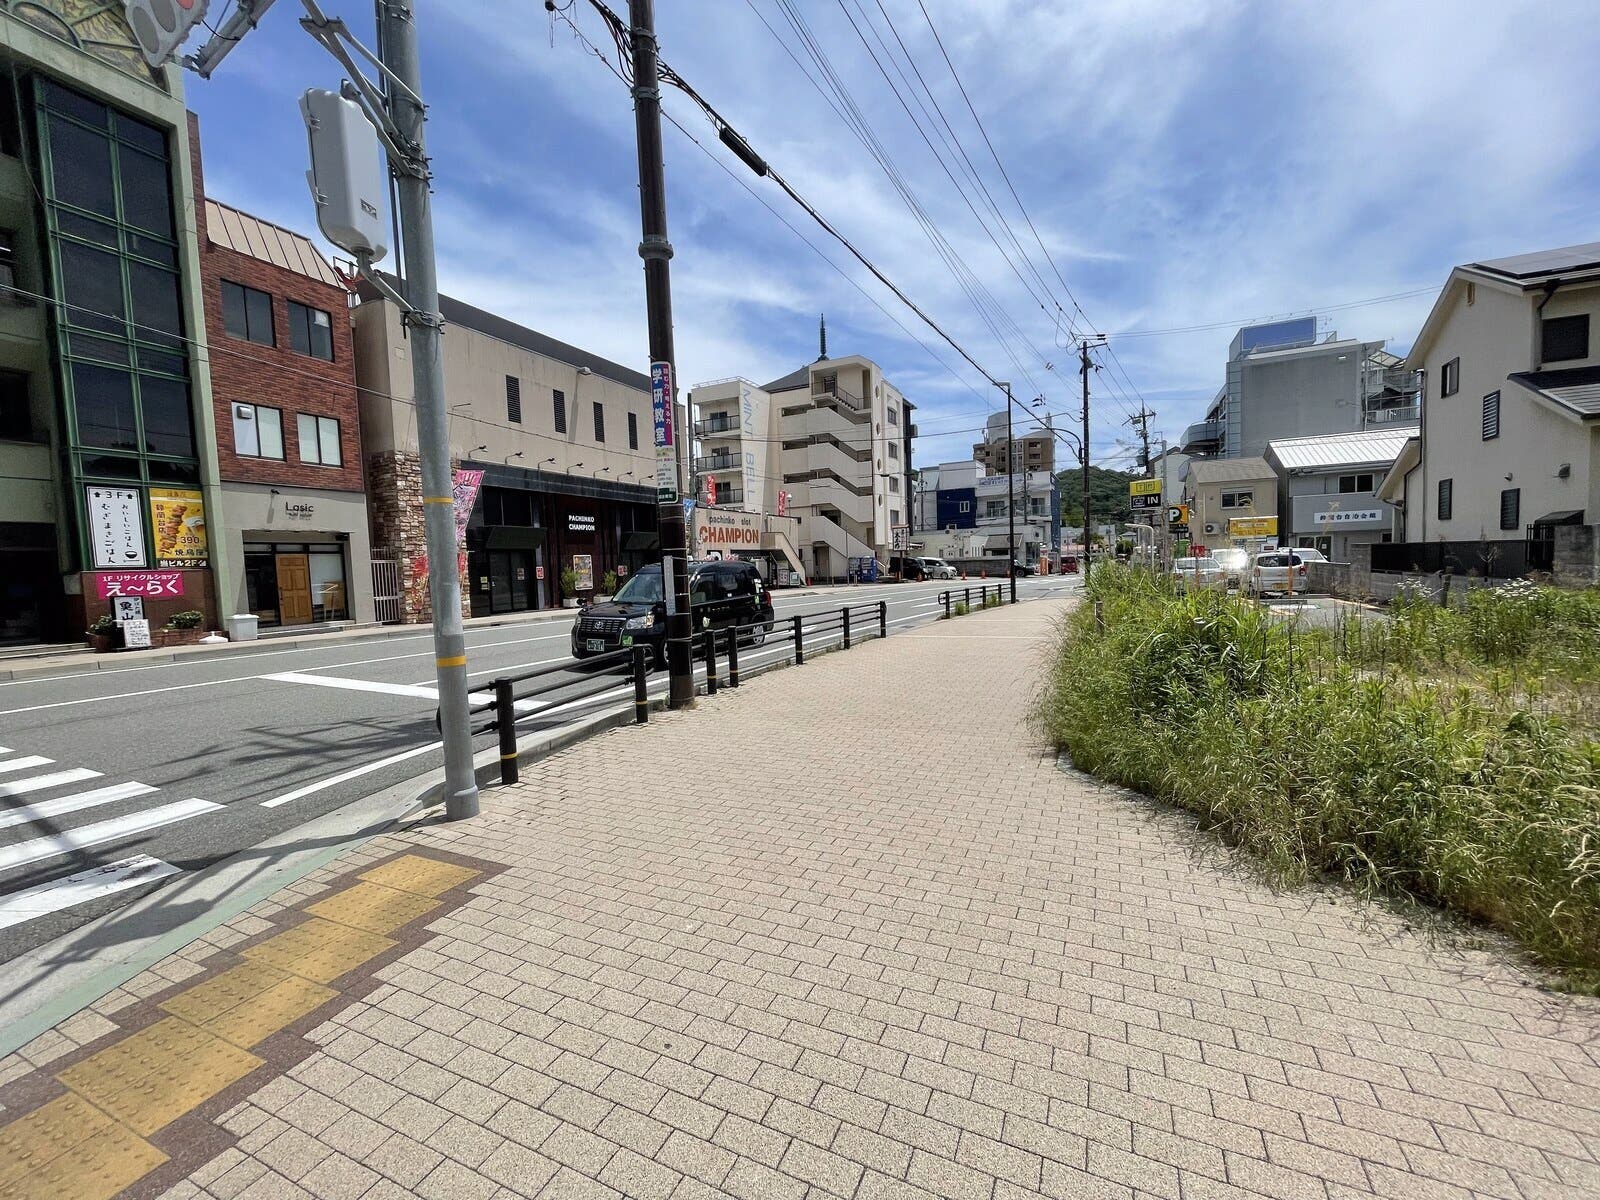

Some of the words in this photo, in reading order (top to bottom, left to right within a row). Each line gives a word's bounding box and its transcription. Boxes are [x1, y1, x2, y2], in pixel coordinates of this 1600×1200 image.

[652, 368, 666, 442] 学研教室
[745, 452, 755, 501] BELL
[105, 491, 123, 499] 3F
[1147, 496, 1159, 504] IN
[285, 501, 314, 512] Lasic
[568, 514, 595, 523] PACHINKO
[709, 515, 736, 525] pachinko
[741, 517, 751, 526] slot
[1169, 509, 1180, 522] P
[568, 523, 596, 531] CHAMPION
[700, 526, 759, 544] CHAMPION
[116, 573, 181, 582] リサイクルショップ
